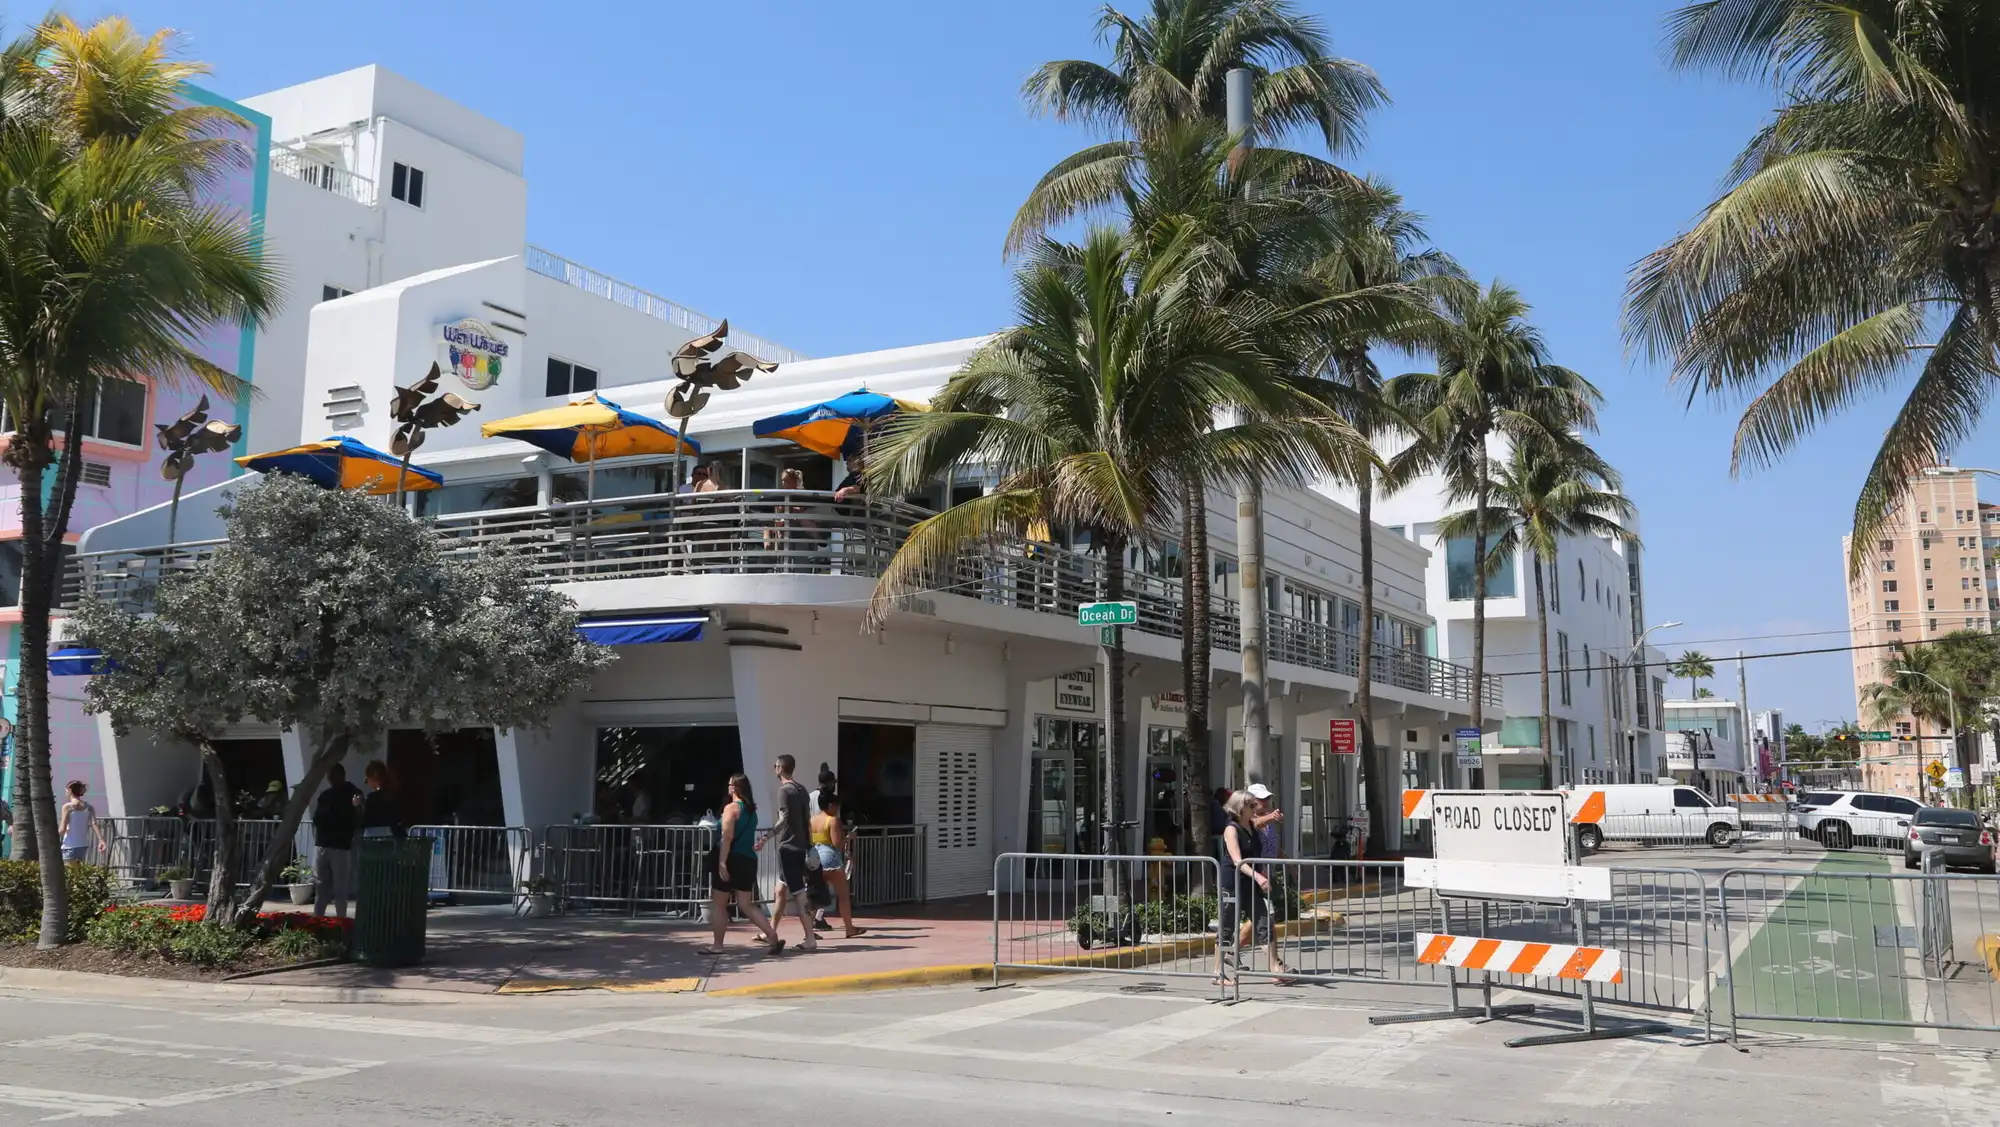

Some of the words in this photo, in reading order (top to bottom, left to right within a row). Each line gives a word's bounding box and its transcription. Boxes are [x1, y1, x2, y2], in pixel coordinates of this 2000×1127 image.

[1081, 609, 1116, 622] Ocean
[1120, 608, 1134, 620] Dr
[1059, 692, 1091, 707] EYEWEAR
[1444, 806, 1481, 830] ROAD
[1494, 806, 1552, 832] CLOSED
